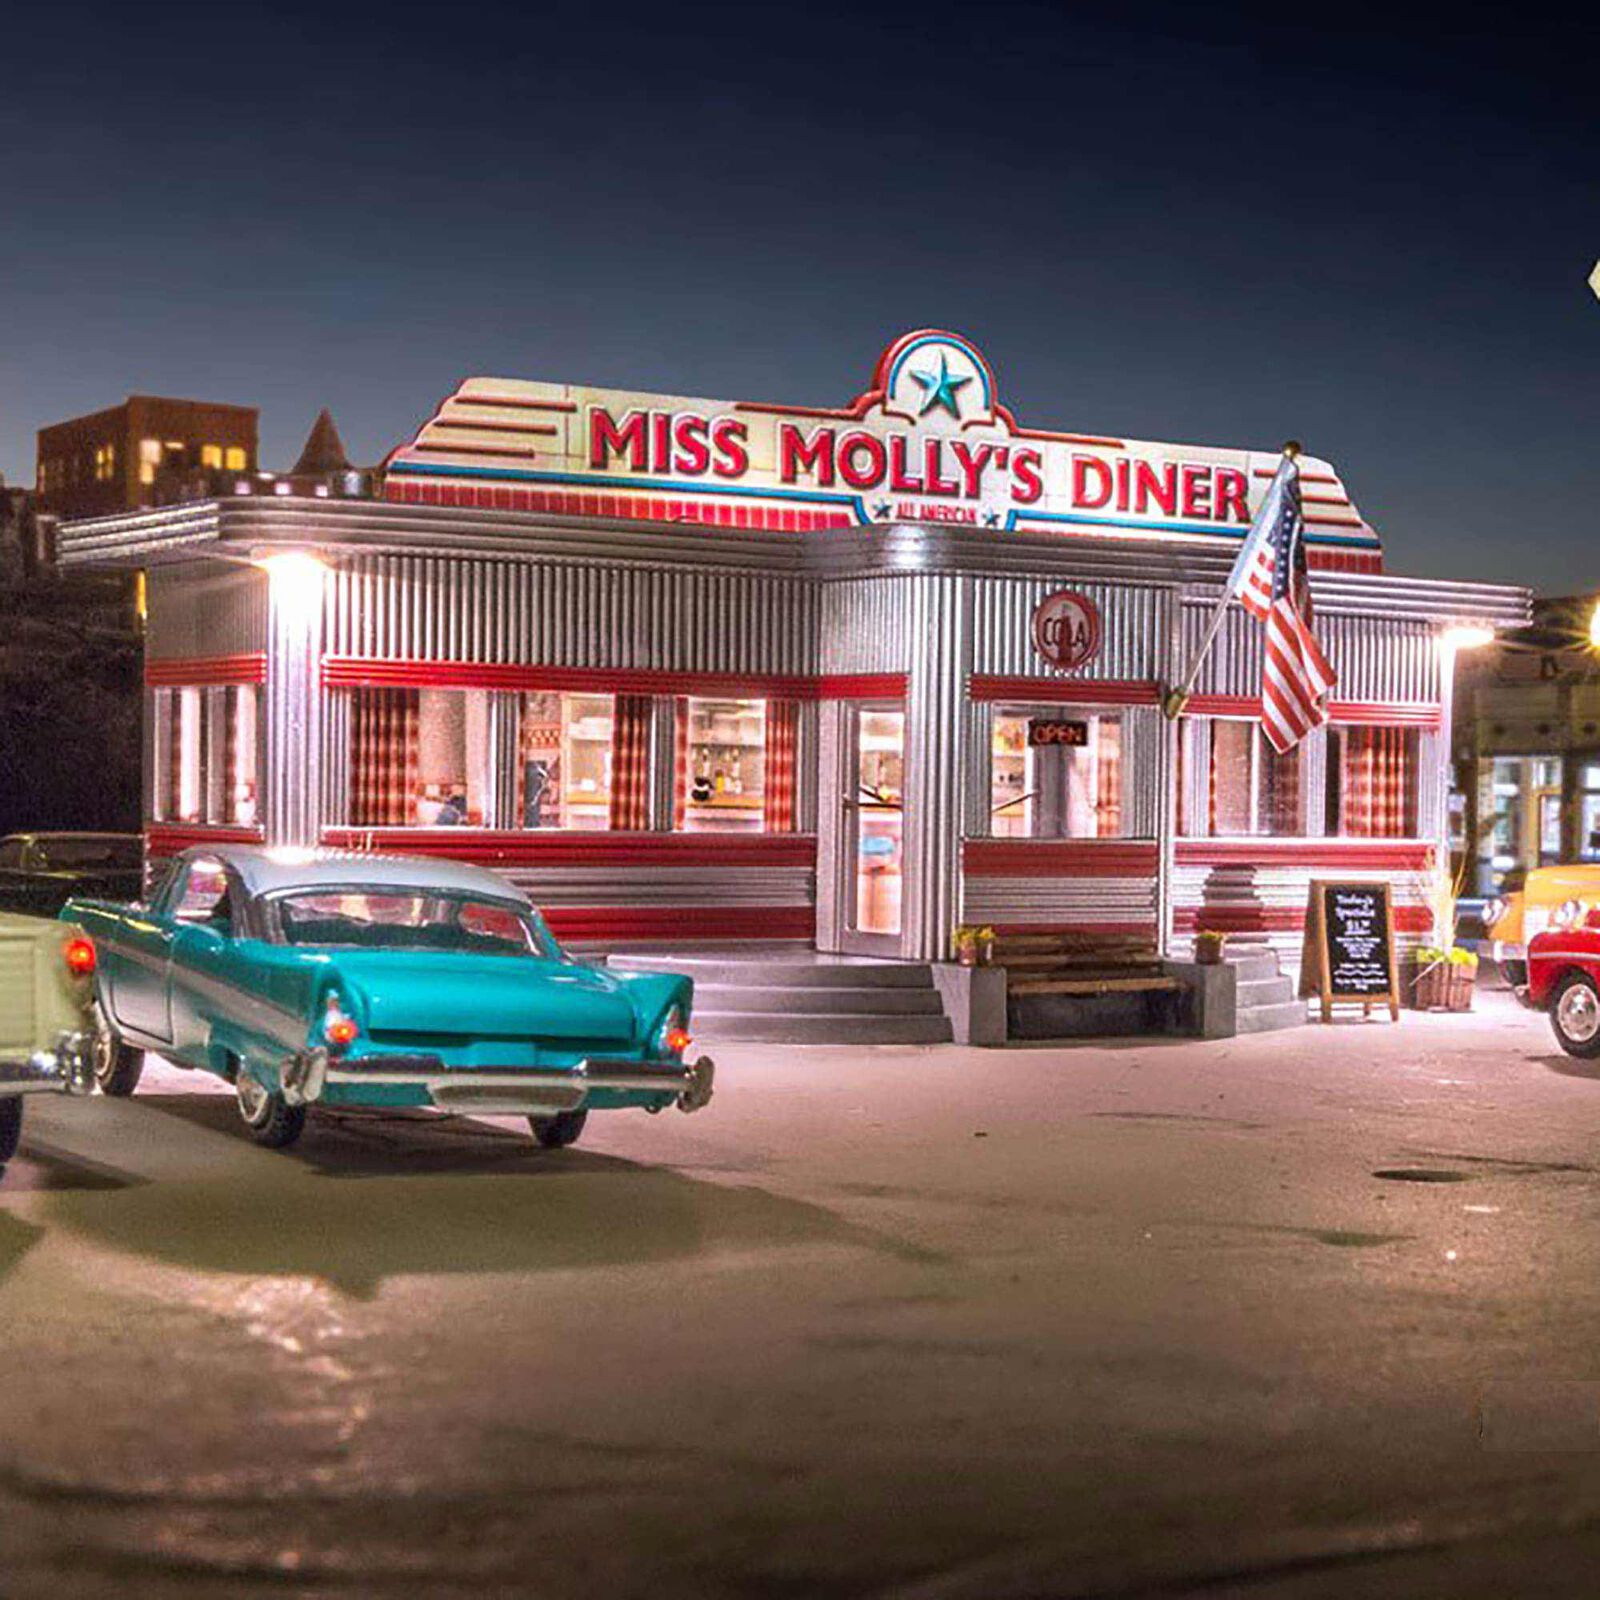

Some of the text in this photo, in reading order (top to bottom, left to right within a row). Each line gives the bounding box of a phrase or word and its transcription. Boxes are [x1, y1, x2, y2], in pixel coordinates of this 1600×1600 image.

[589, 406, 1250, 524] MISS MOLLY'S DINER
[1043, 617, 1086, 649] COA
[1033, 726, 1083, 744] OPEN
